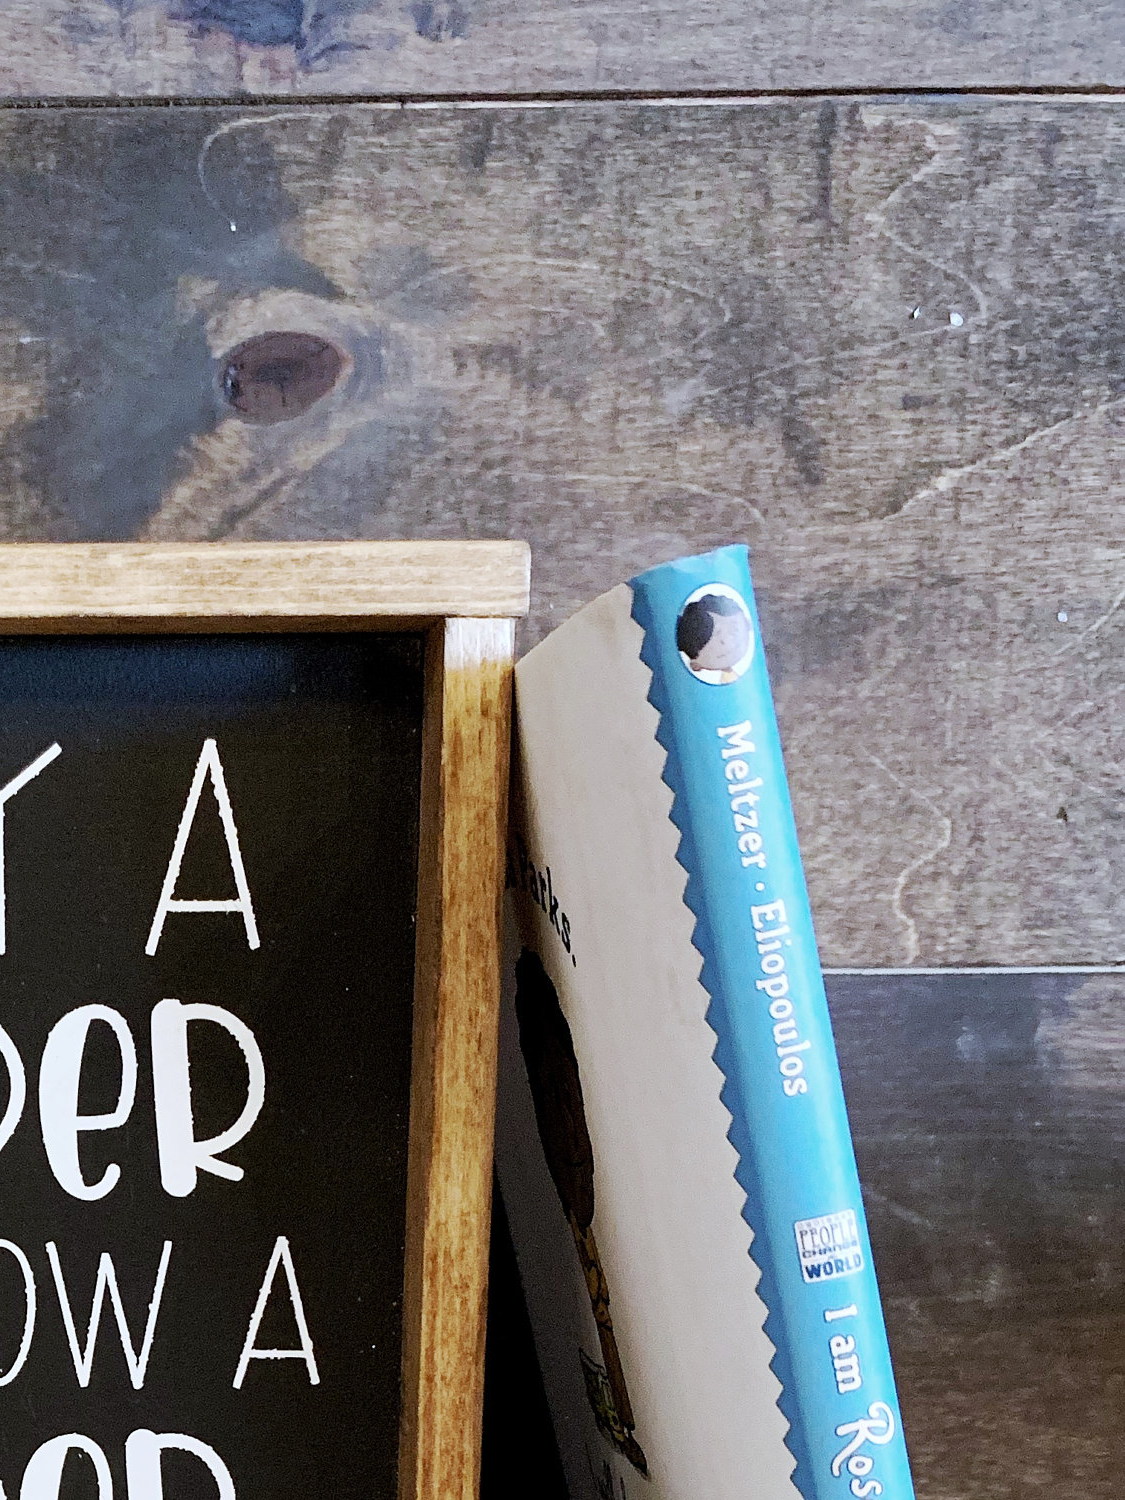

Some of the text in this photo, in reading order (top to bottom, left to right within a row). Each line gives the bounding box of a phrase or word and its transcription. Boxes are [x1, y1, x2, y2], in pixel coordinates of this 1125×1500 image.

[145, 738, 261, 956] A
[716, 718, 816, 1098] Meltzer Eliopoulos
[232, 1236, 321, 1388] A
[804, 1253, 862, 1279] WORLD
[823, 1302, 859, 1324] I
[827, 1333, 864, 1395] am
